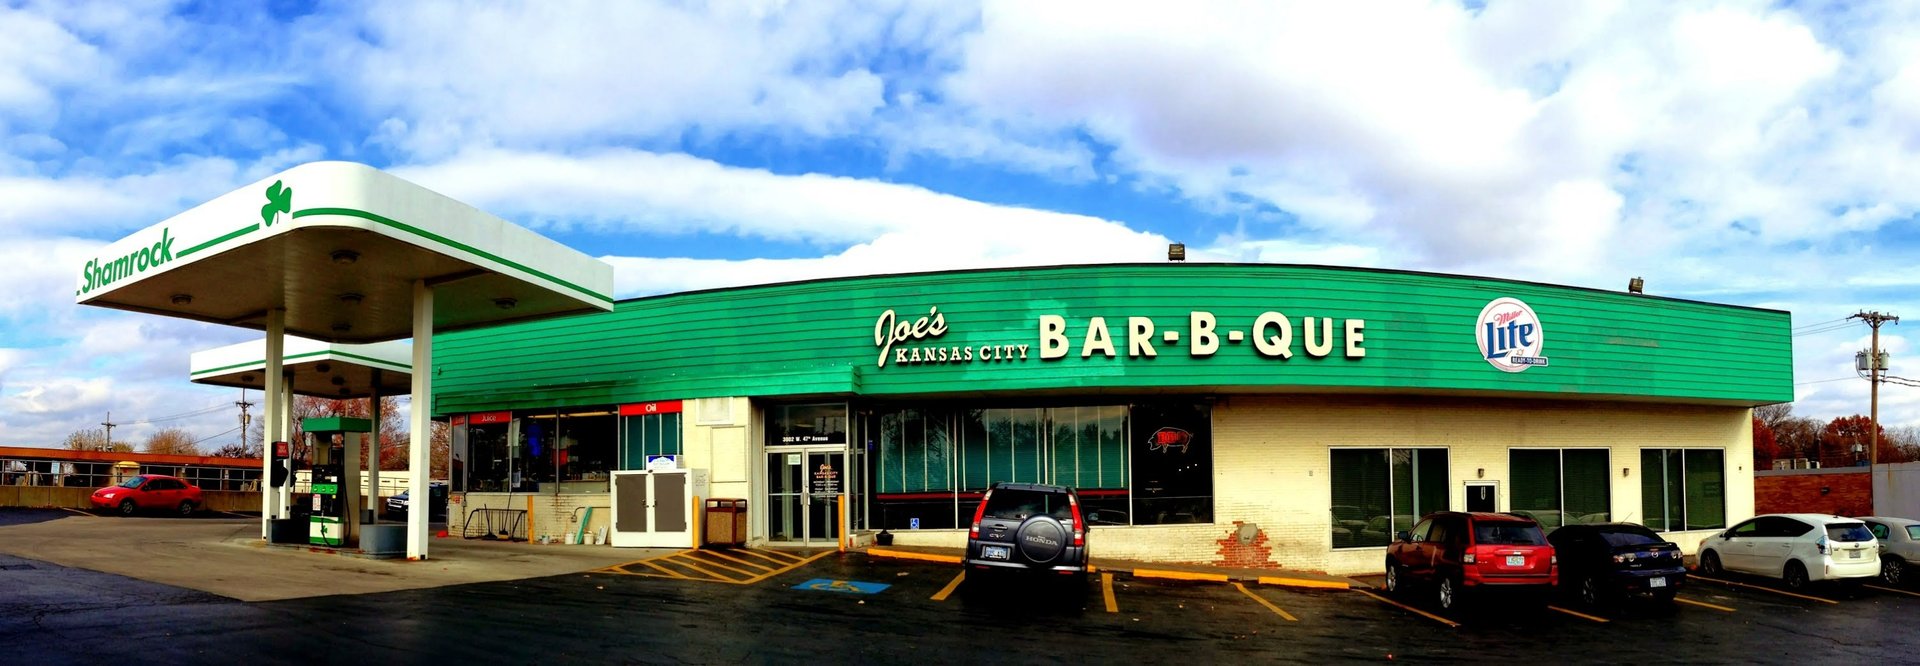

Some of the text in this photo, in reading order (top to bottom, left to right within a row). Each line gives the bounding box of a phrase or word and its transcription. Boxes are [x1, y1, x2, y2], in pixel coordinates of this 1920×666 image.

[82, 227, 175, 293] Shamrock
[1494, 311, 1522, 325] Miller
[874, 305, 948, 368] Joe's
[1039, 311, 1366, 359] BAR-B-QUE
[1485, 320, 1534, 359] Lite
[895, 343, 1029, 364] KANSAS CITY
[645, 403, 657, 412] Oil
[1025, 536, 1058, 546] HONDA
